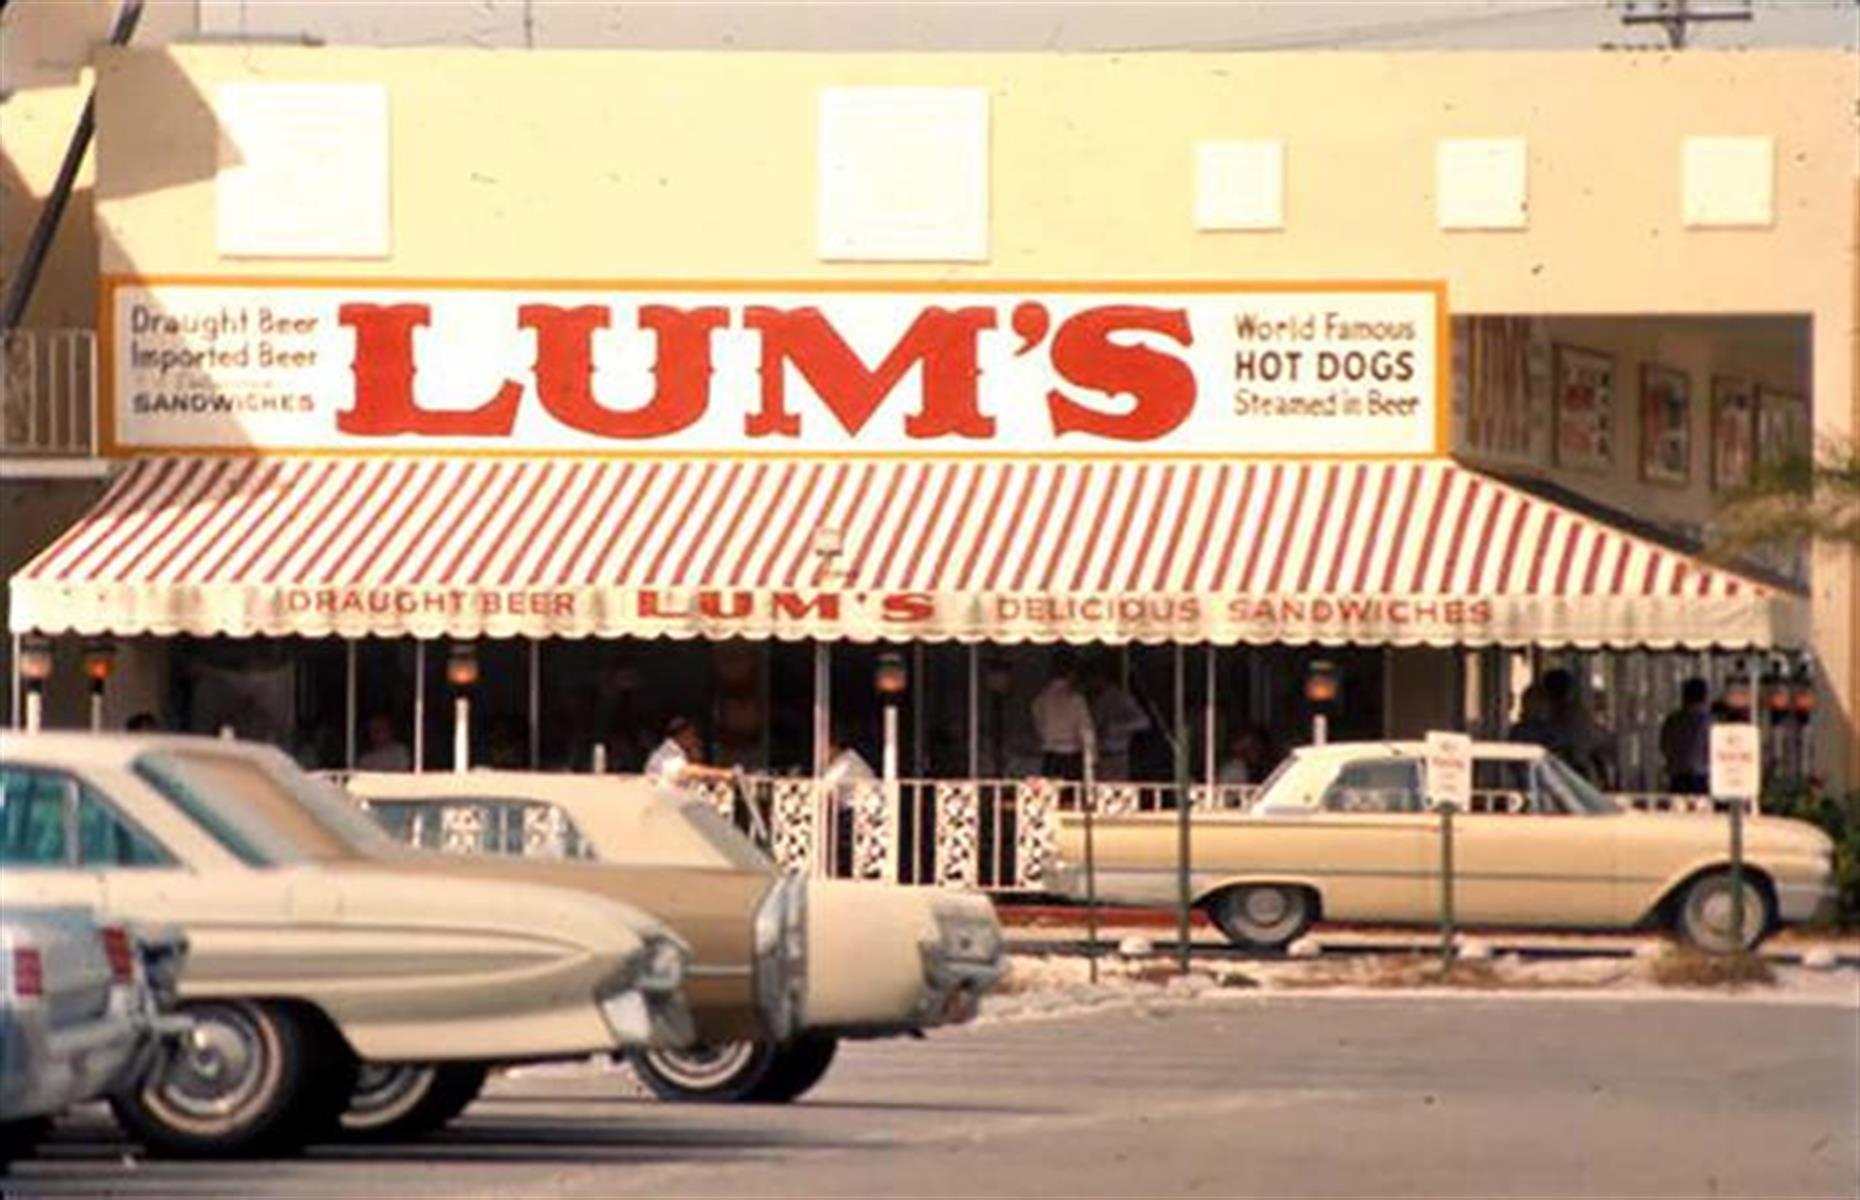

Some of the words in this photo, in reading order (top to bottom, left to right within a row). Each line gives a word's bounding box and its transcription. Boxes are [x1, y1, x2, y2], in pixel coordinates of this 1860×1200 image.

[131, 306, 248, 340] Draught
[258, 308, 318, 333] Beer
[1235, 313, 1316, 341] World
[1324, 312, 1416, 341] Famous
[131, 340, 248, 373] Imported
[258, 341, 317, 368] Beer
[336, 302, 1198, 440] LUM'S
[1234, 351, 1302, 381] HOT
[1317, 350, 1415, 381] DOGS
[132, 393, 315, 414] SANDWICHES
[1234, 388, 1336, 416] Steamed
[1341, 388, 1362, 415] in
[1368, 389, 1420, 416] Beer
[288, 590, 466, 615] DRAUGHT
[482, 591, 577, 616] BEER
[637, 589, 935, 621] LUM'S
[997, 597, 1201, 623] DELICIOUS
[1228, 599, 1493, 624] SANDWICHES
